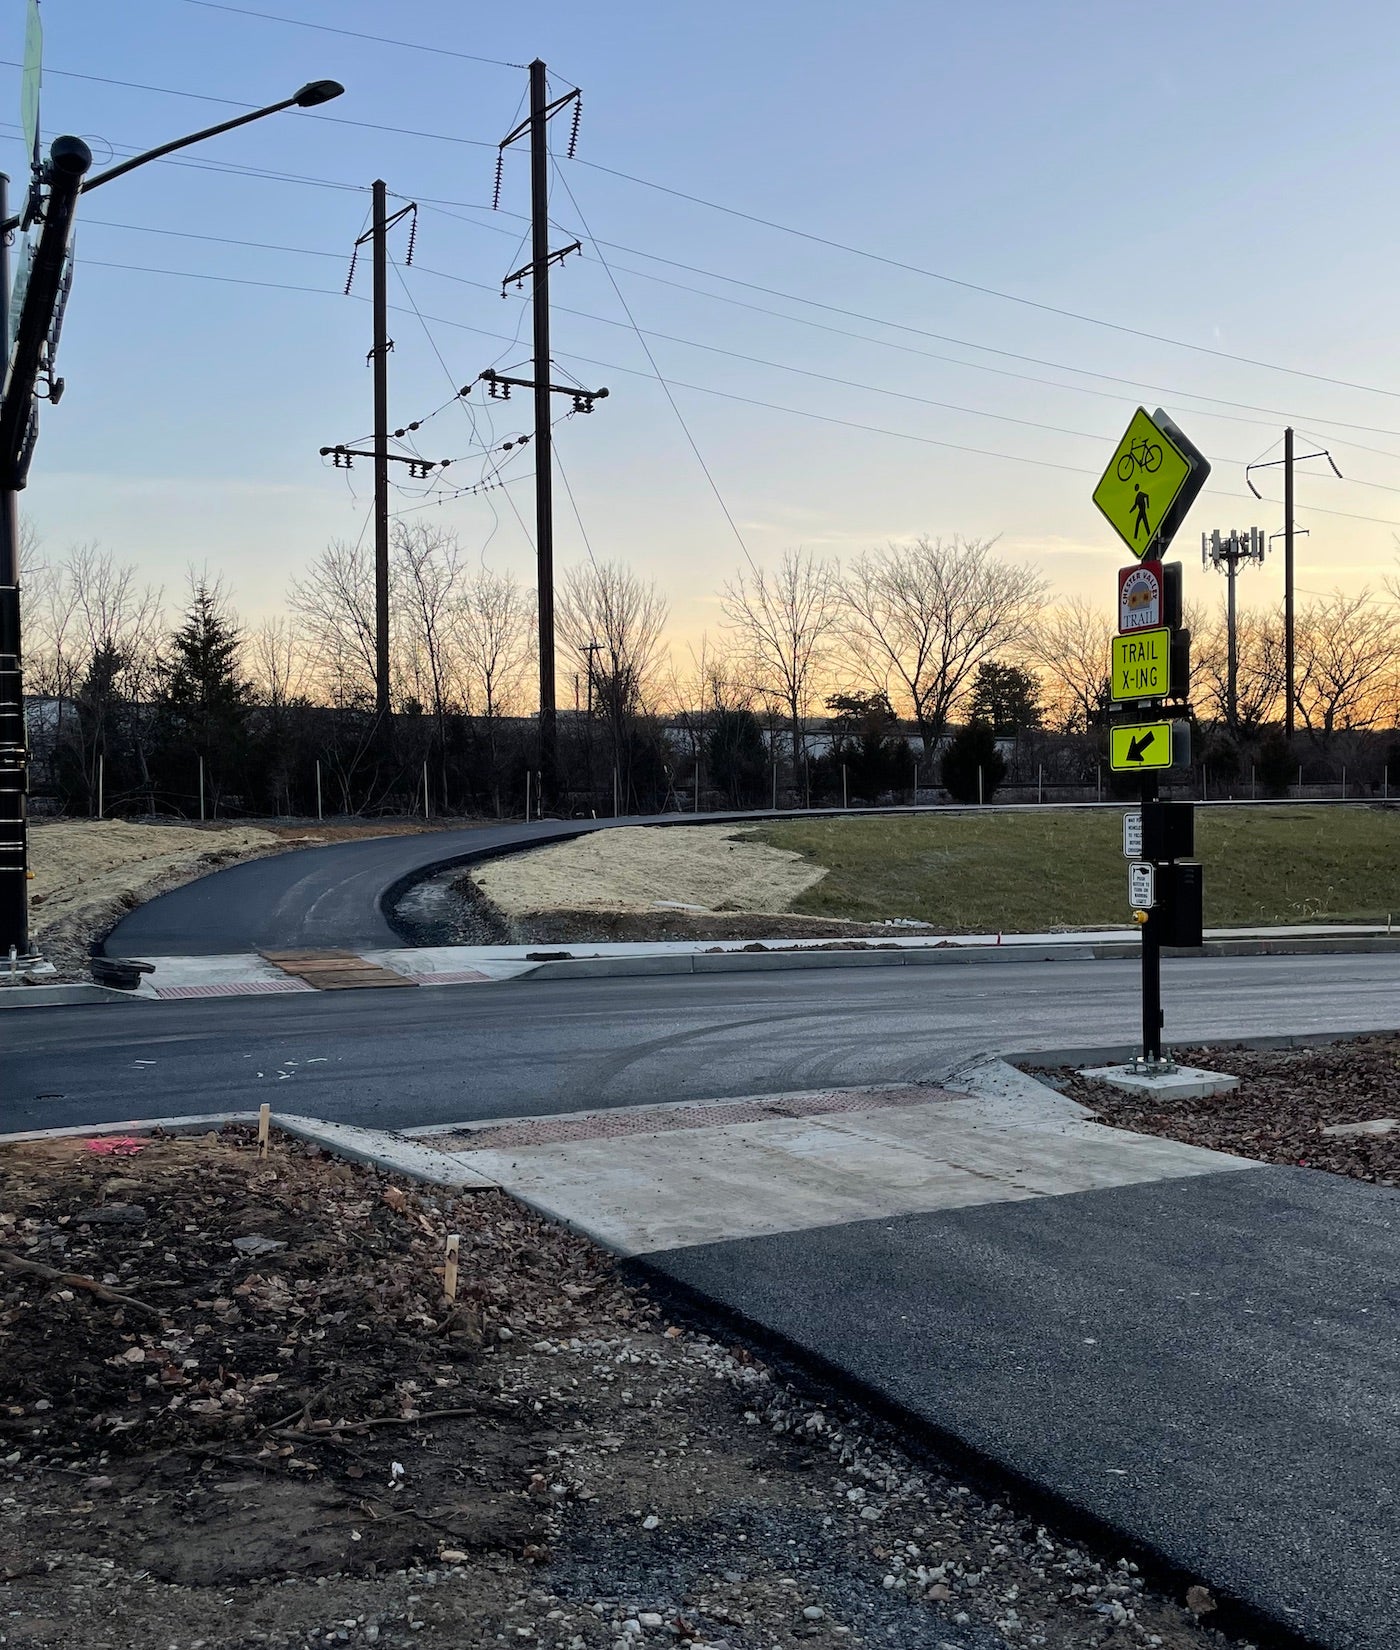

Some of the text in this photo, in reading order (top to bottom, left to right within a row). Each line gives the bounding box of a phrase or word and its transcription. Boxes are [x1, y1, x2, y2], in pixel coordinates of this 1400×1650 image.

[1123, 572, 1158, 605] CHESTER VALLEY
[1124, 611, 1156, 627] TRAIL
[1122, 641, 1158, 664] TRAIL
[1122, 667, 1157, 690] X-ING
